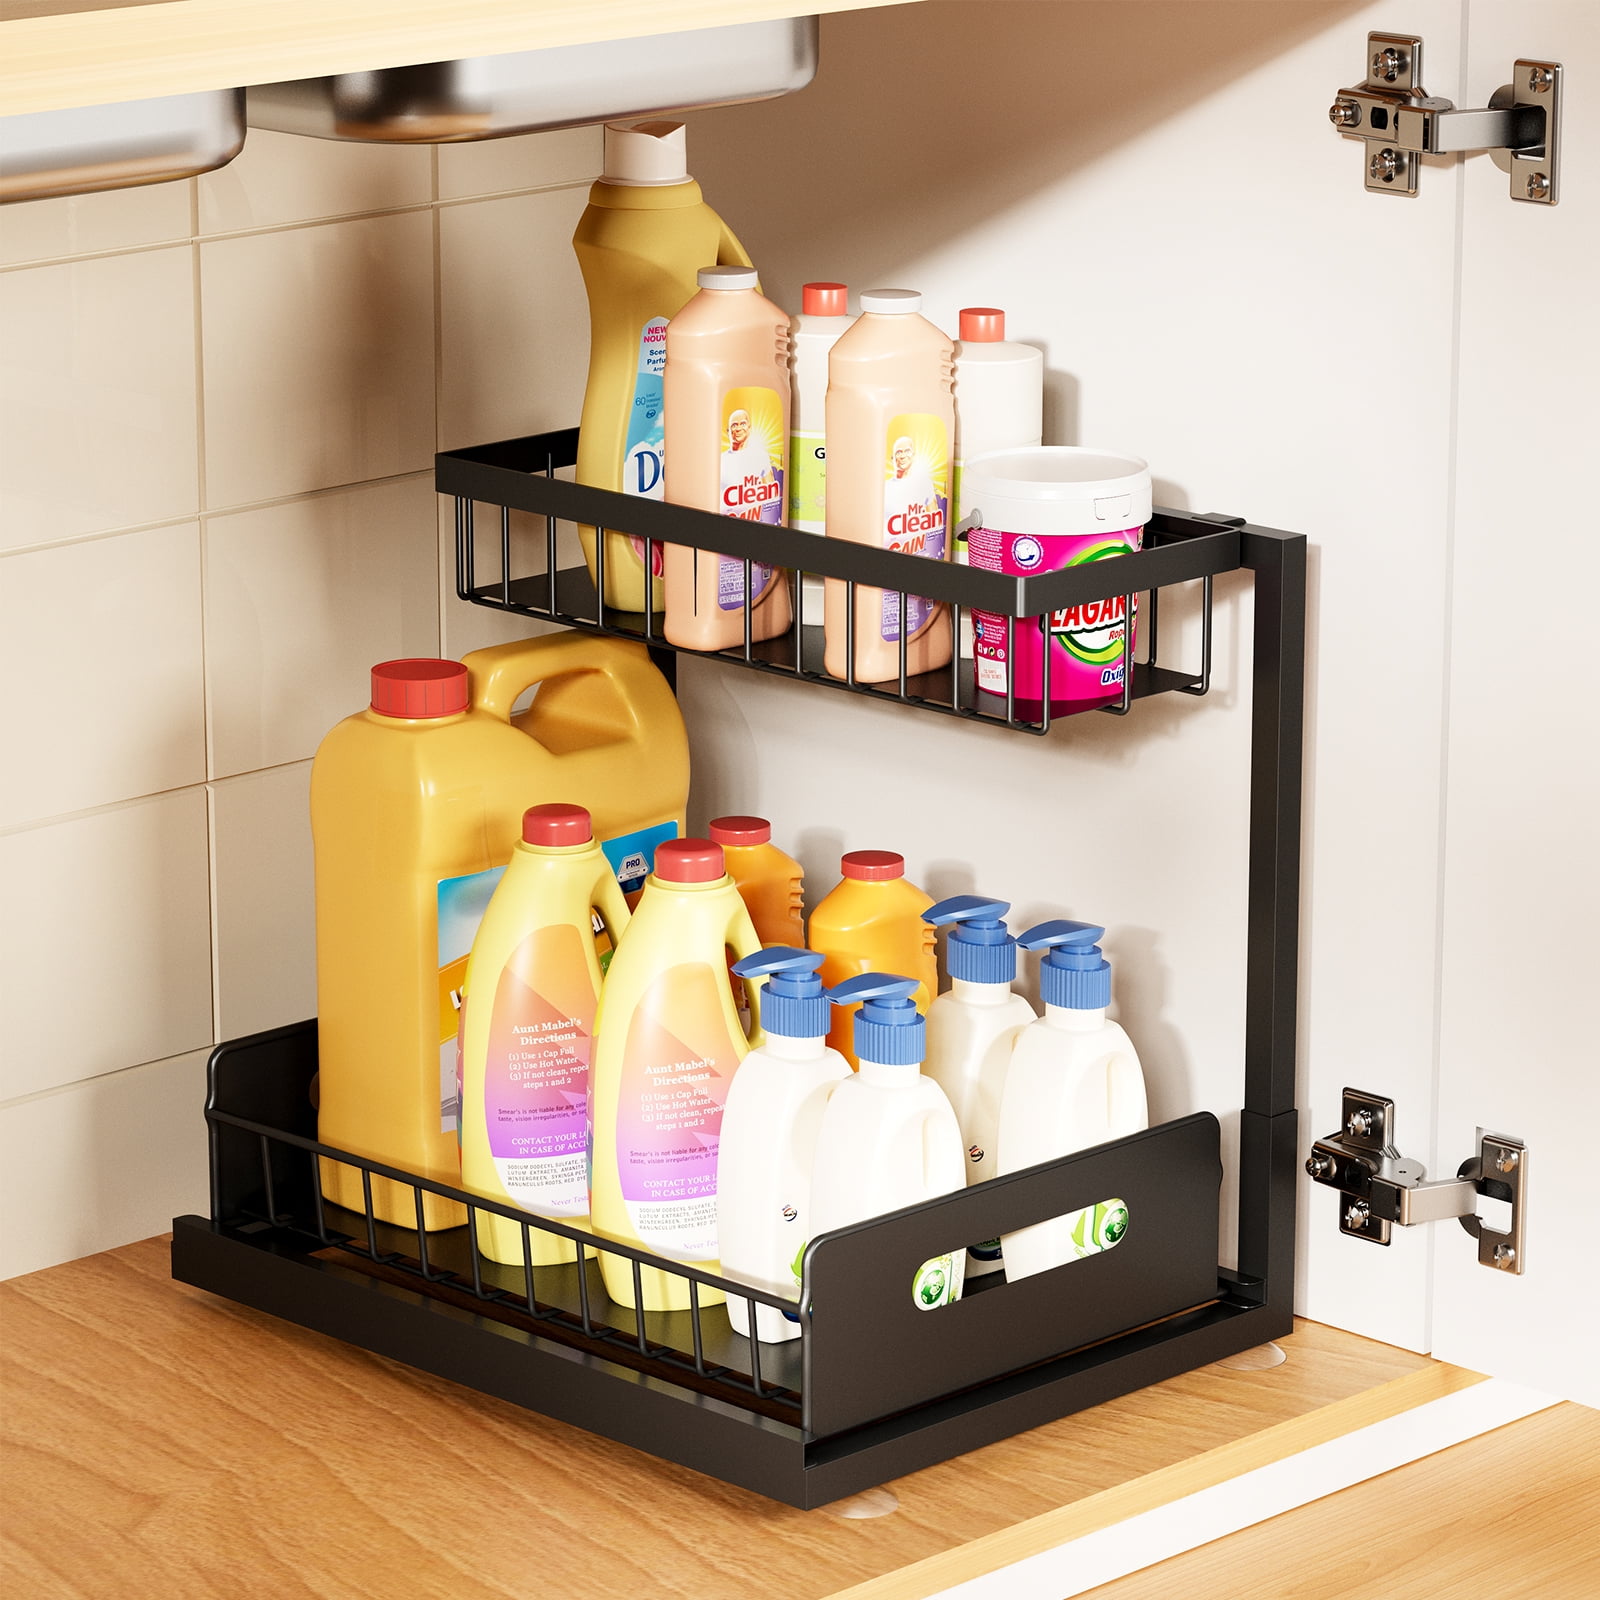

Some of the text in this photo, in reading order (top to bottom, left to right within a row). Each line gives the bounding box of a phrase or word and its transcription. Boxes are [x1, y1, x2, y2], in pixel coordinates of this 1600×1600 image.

[636, 397, 646, 406] 60
[744, 475, 761, 487] Mr.
[724, 482, 778, 506] Clean
[728, 505, 762, 520] AIN
[908, 504, 925, 516] Mr.
[888, 511, 942, 535] Clean
[1050, 592, 1126, 627] LAGAR
[626, 858, 640, 869] PRO
[512, 1018, 581, 1033] Aunt Mabel's
[520, 1032, 576, 1045] Directions
[509, 1053, 519, 1061] (1)
[560, 1047, 574, 1055] Full
[644, 1058, 715, 1074] Aunt Mabel's
[510, 1072, 521, 1080] (3)
[546, 1069, 568, 1077] clean,
[653, 1072, 710, 1086] Directions
[523, 1081, 543, 1090] steps
[551, 1078, 565, 1086] and
[676, 1091, 691, 1099] Cap
[693, 1088, 708, 1096] Full
[689, 1098, 712, 1106] Water
[680, 1110, 702, 1118] clean,
[684, 1119, 698, 1128] and
[512, 1136, 552, 1145] CONTACT
[555, 1133, 577, 1143] YOUR
[531, 1145, 552, 1153] CASE
[644, 1179, 685, 1188] CONTACT
[688, 1175, 710, 1184] YOUR
[663, 1188, 685, 1197] CASE
